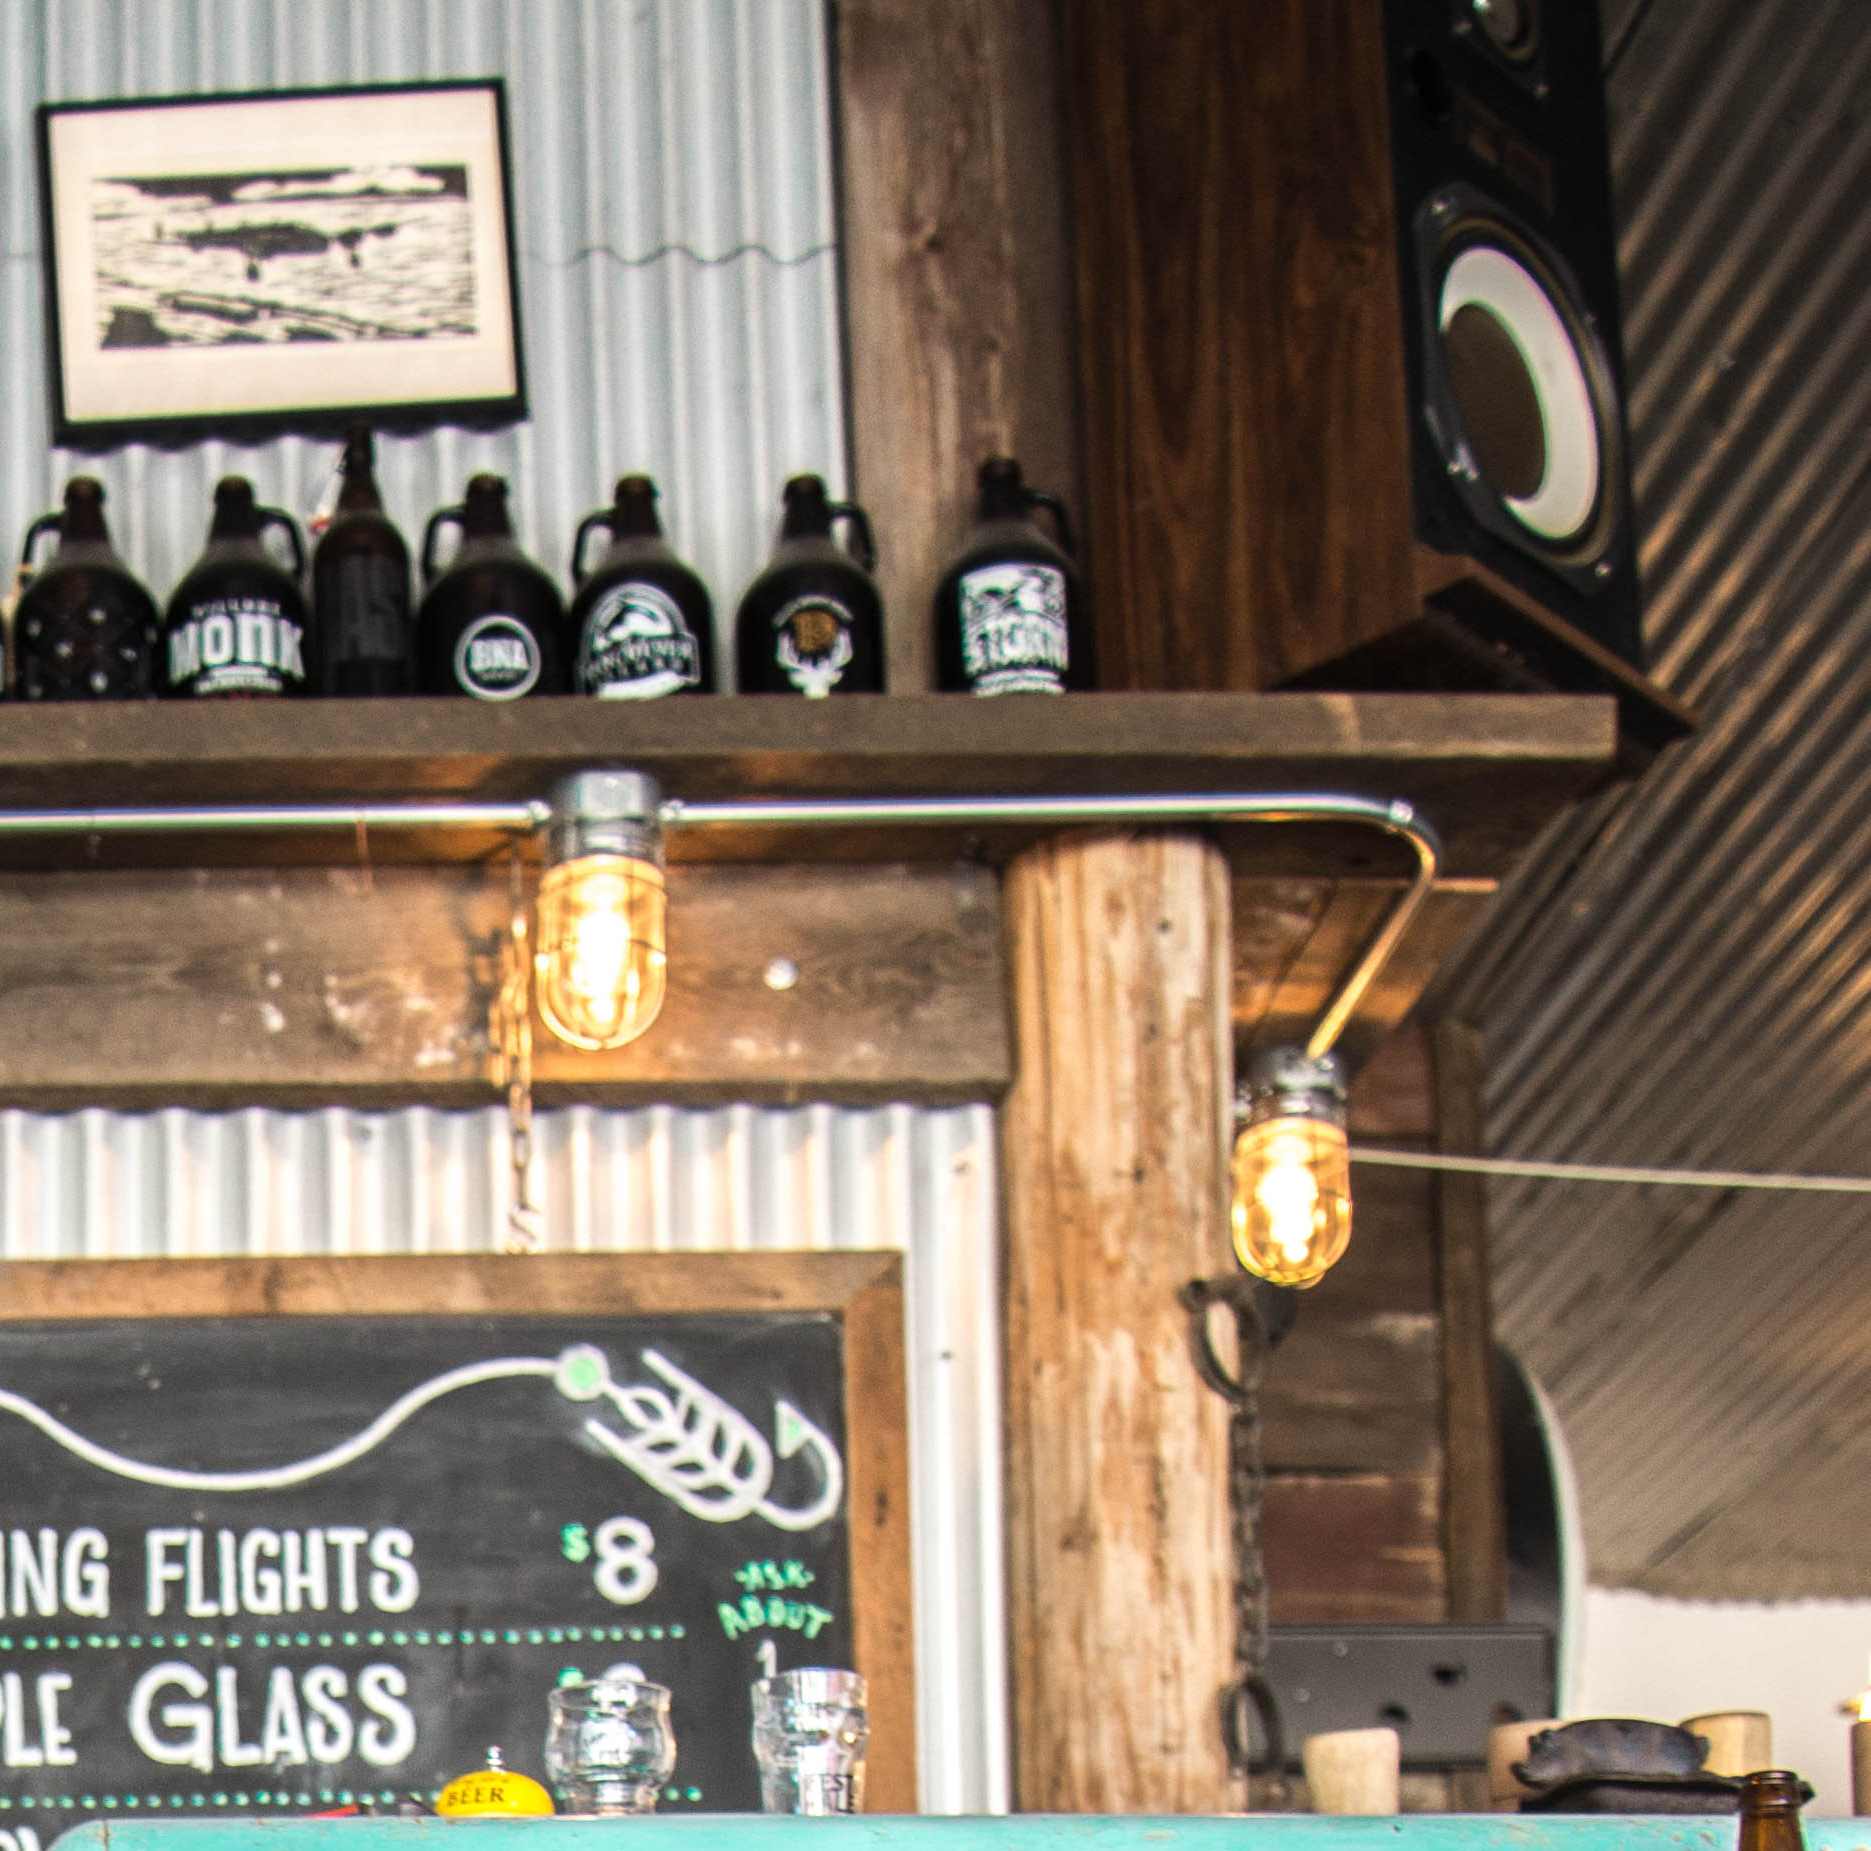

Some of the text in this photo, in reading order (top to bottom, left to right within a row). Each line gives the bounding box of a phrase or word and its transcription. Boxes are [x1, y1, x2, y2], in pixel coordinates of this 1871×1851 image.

[145, 1526, 420, 1618] FLIGHTS
[560, 1515, 658, 1605] $8
[717, 1593, 834, 1641] ABOUT
[128, 1661, 417, 1774] GLASS
